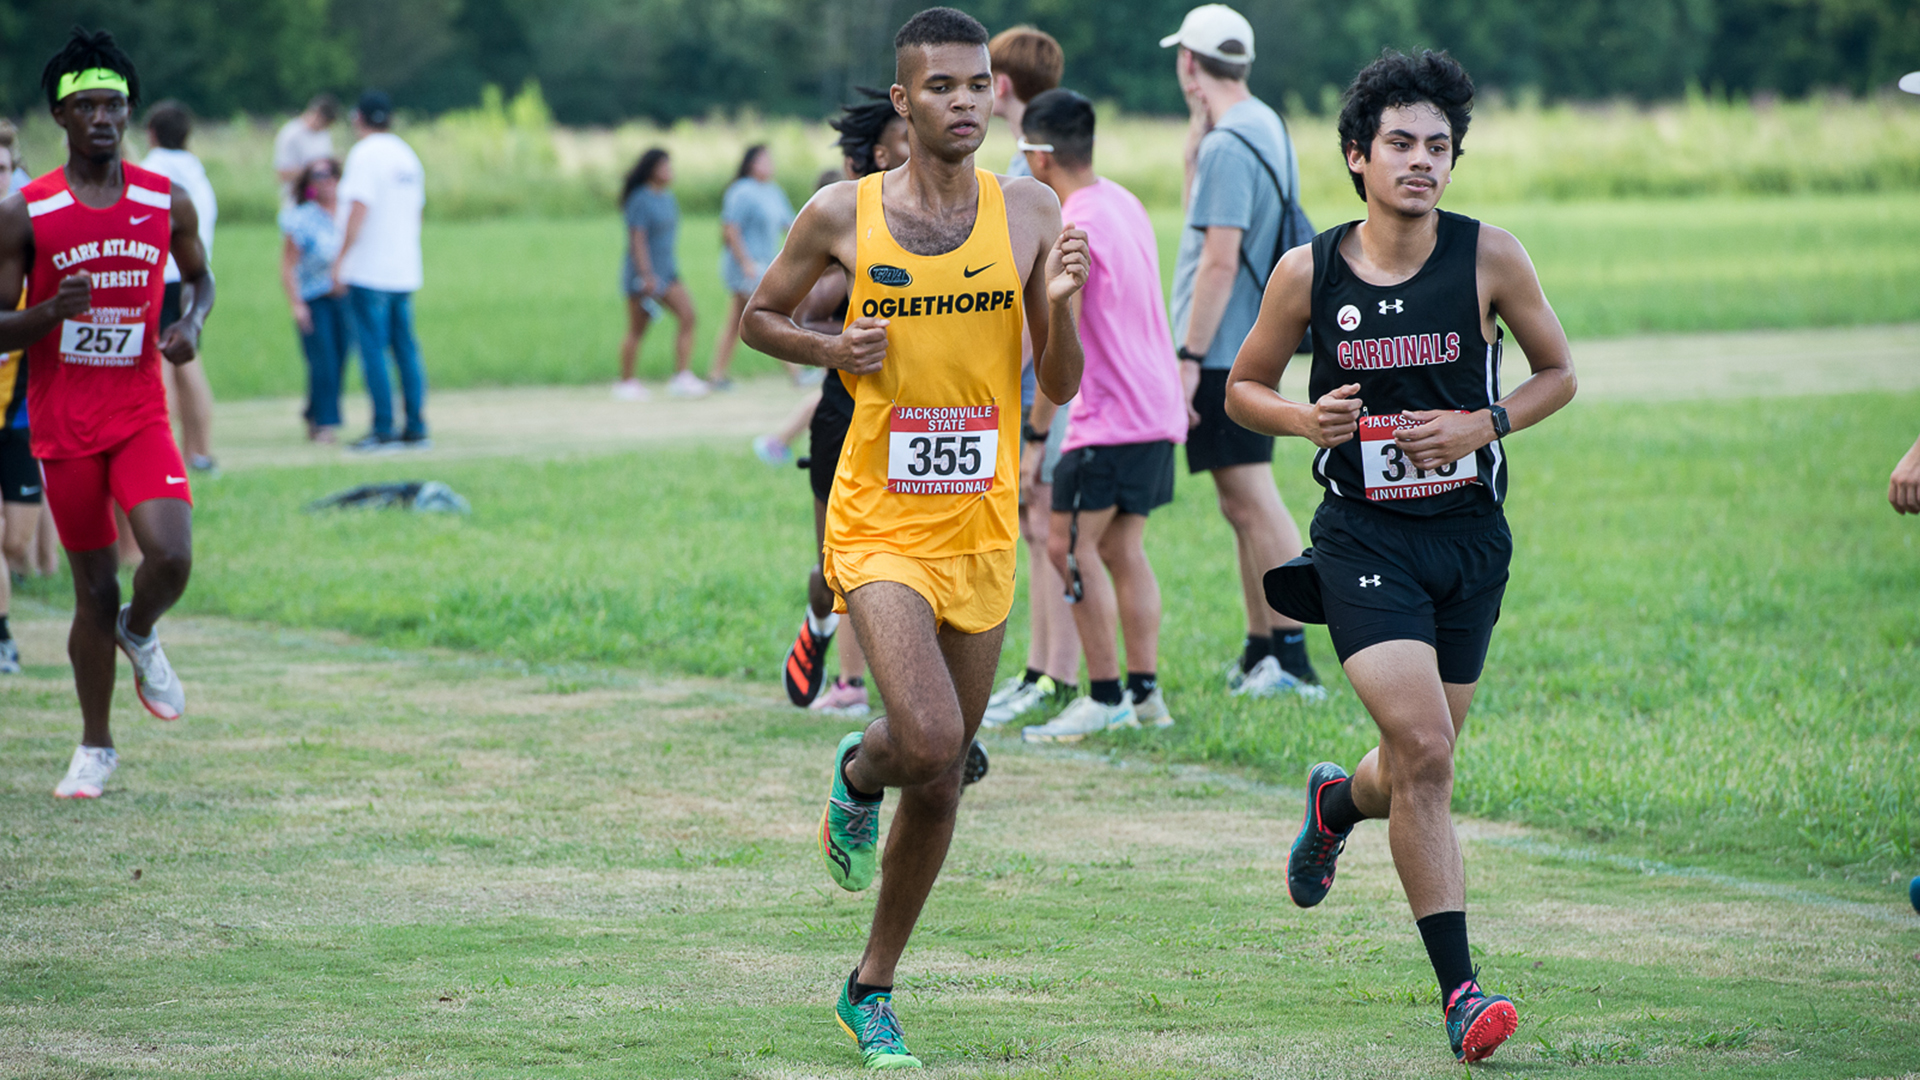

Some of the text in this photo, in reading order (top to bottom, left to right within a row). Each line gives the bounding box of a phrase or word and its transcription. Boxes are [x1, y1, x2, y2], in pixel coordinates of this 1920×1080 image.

[52, 238, 160, 270] CLARK ATLANTA
[66, 269, 149, 289] VERSITY
[862, 290, 1015, 318] OGLETHORPE
[92, 315, 120, 324] STATE
[75, 326, 132, 354] 257
[65, 354, 134, 366] INVITATIONAL
[1338, 331, 1460, 370] CARDINALS
[899, 406, 992, 420] JACKSONVILLE
[928, 419, 966, 431] STATE
[907, 436, 982, 476] 355
[896, 480, 987, 494] INVITATIONAL
